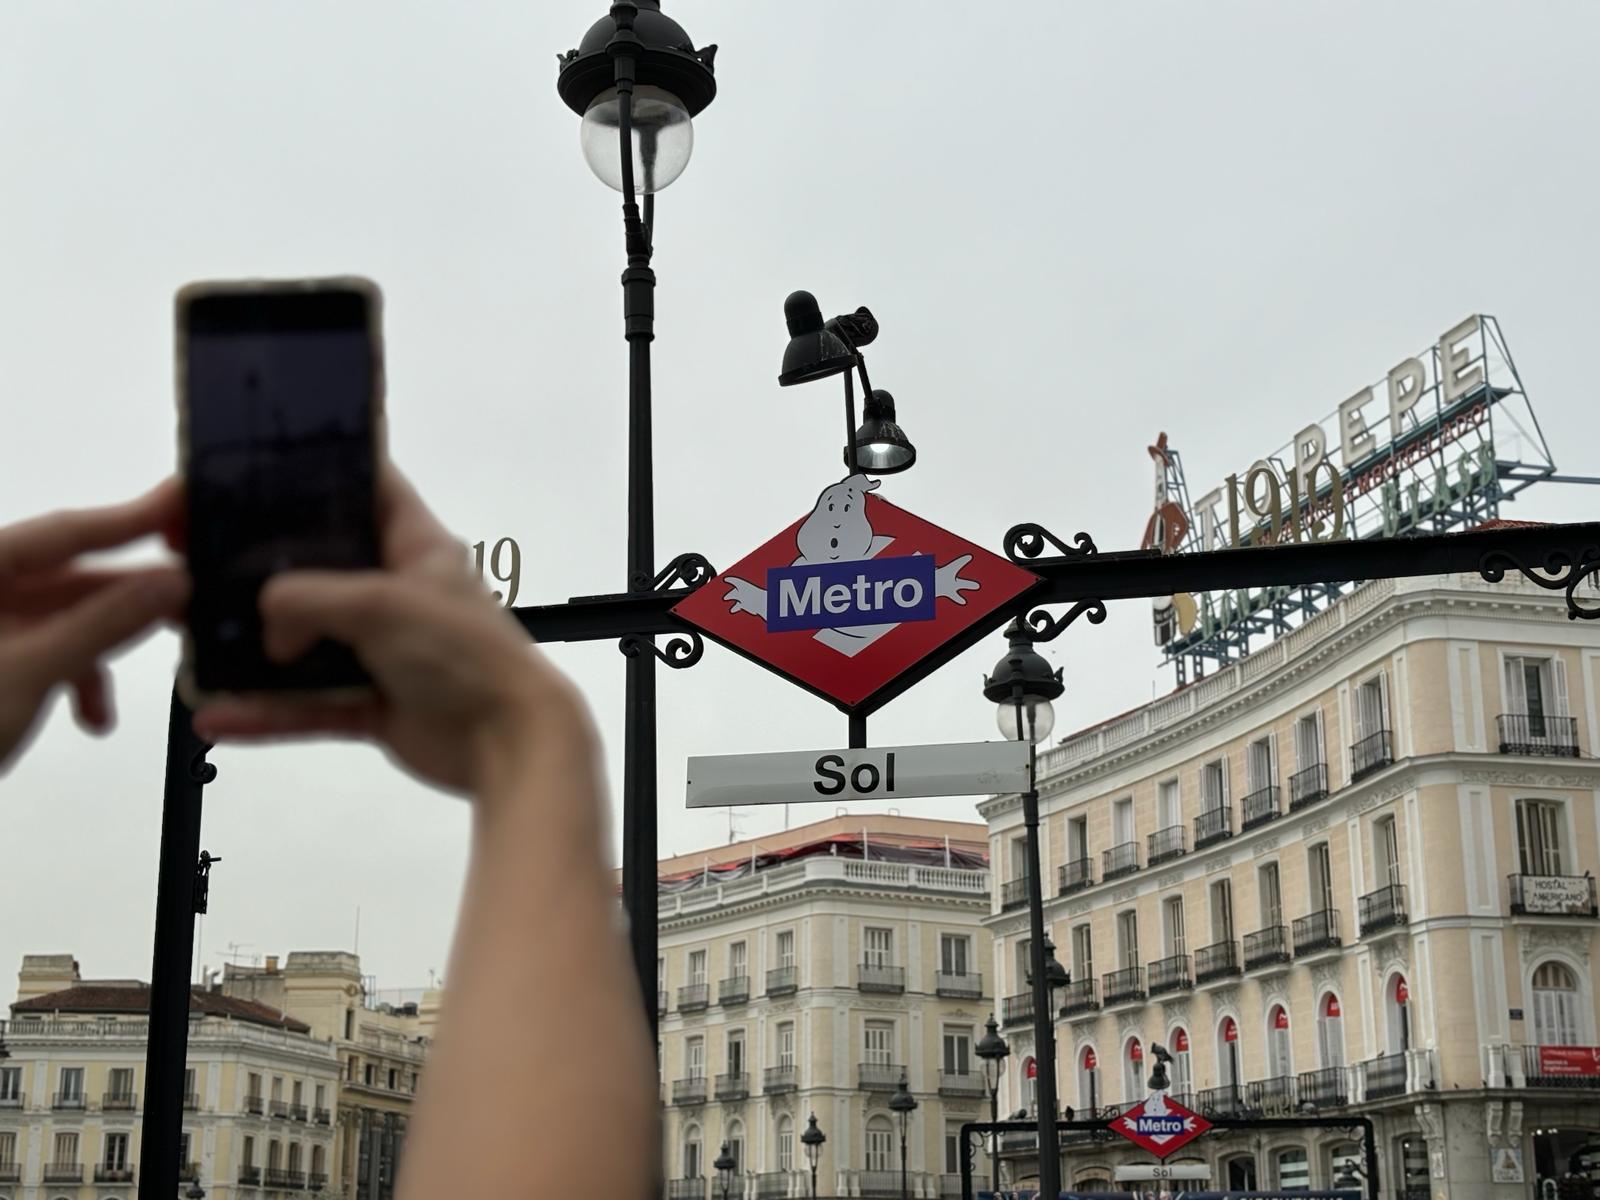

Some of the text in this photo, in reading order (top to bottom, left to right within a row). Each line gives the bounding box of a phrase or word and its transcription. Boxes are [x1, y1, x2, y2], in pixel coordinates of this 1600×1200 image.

[1293, 313, 1483, 498] PEPE
[1225, 463, 1344, 547] 1919
[779, 574, 923, 618] Metro
[813, 752, 895, 796] Sol
[1139, 1118, 1182, 1132] Metro
[1152, 1167, 1173, 1178] Sol
